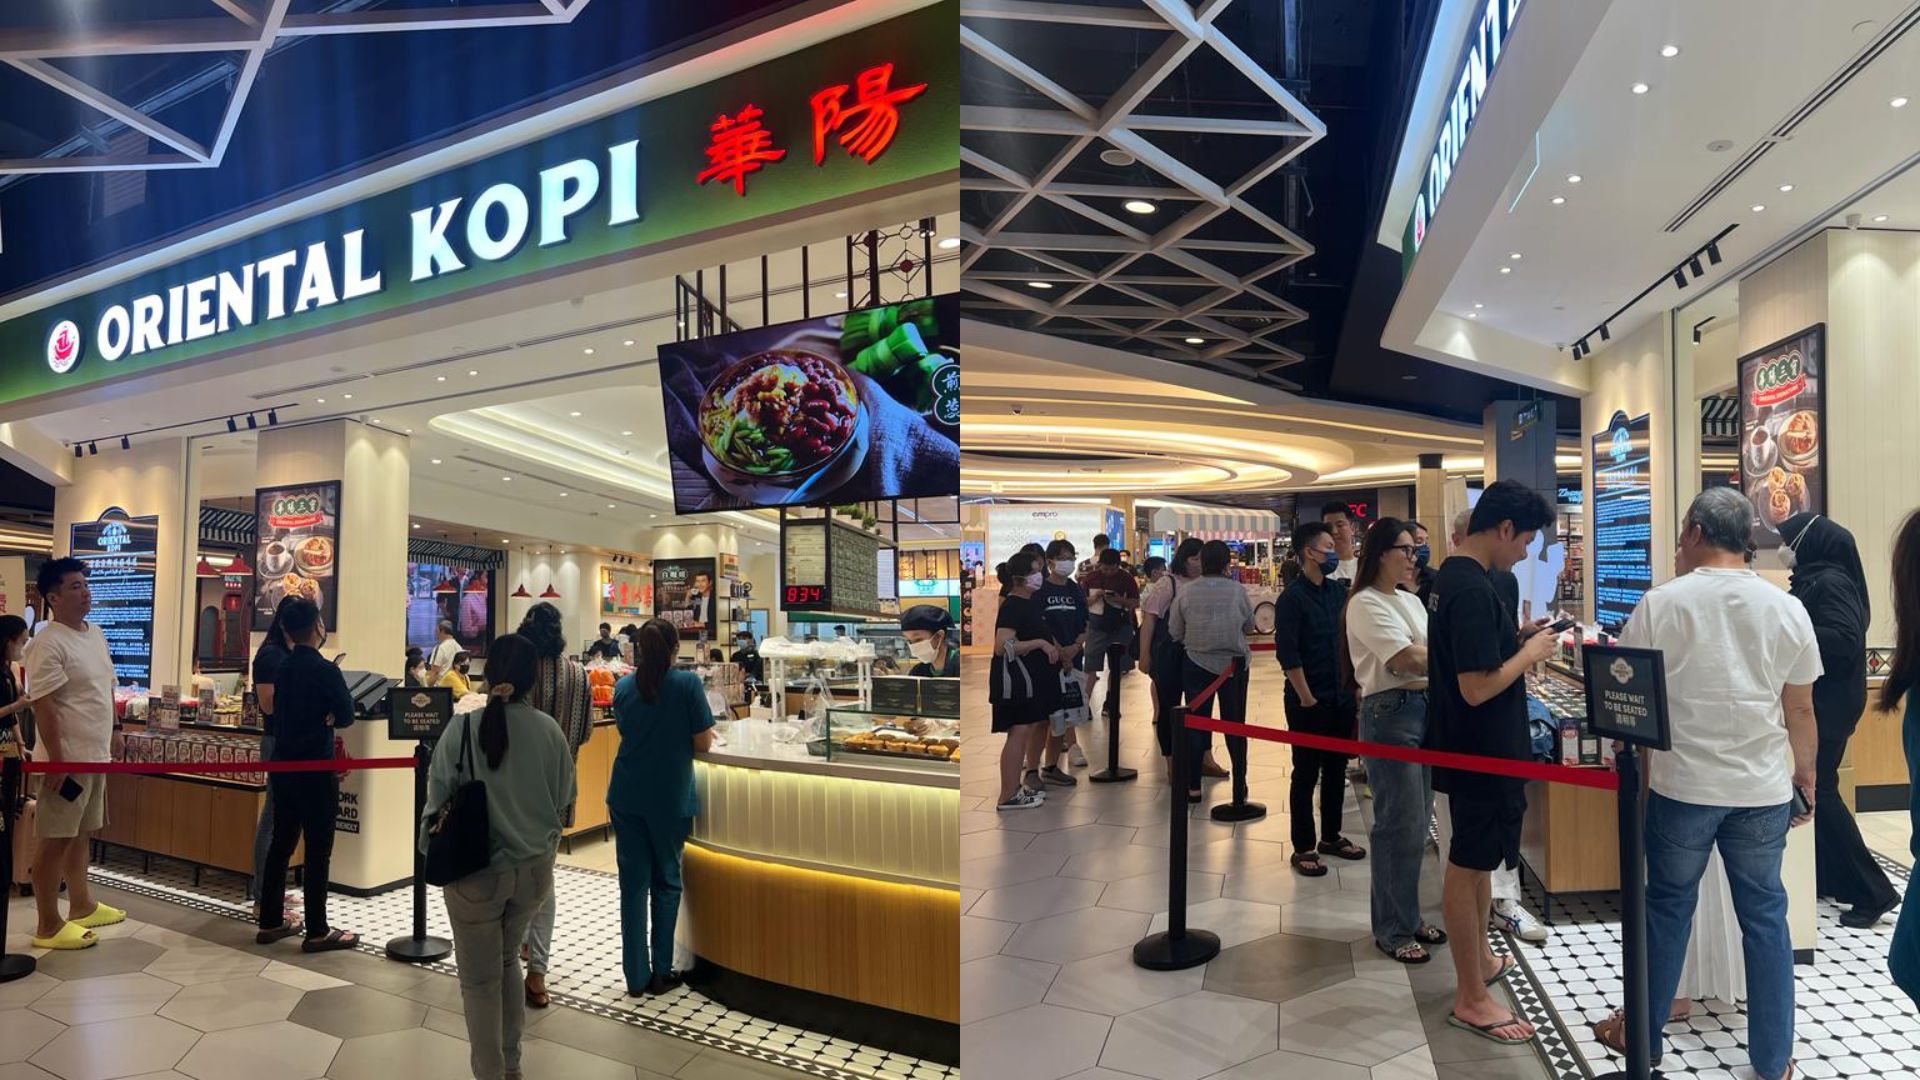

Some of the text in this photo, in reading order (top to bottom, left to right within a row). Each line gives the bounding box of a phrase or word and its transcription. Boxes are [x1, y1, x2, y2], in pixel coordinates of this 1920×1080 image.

[1429, 0, 1520, 220] ORIENT
[696, 62, 927, 196] 華陽
[97, 138, 641, 362] ORIENTAL KOPI
[1032, 511, 1058, 519] empro
[97, 534, 132, 546] ORIENTAL
[787, 587, 820, 602] 834
[1605, 690, 1645, 704] PLEASE WAIT
[1604, 700, 1647, 716] TO BE SEATED
